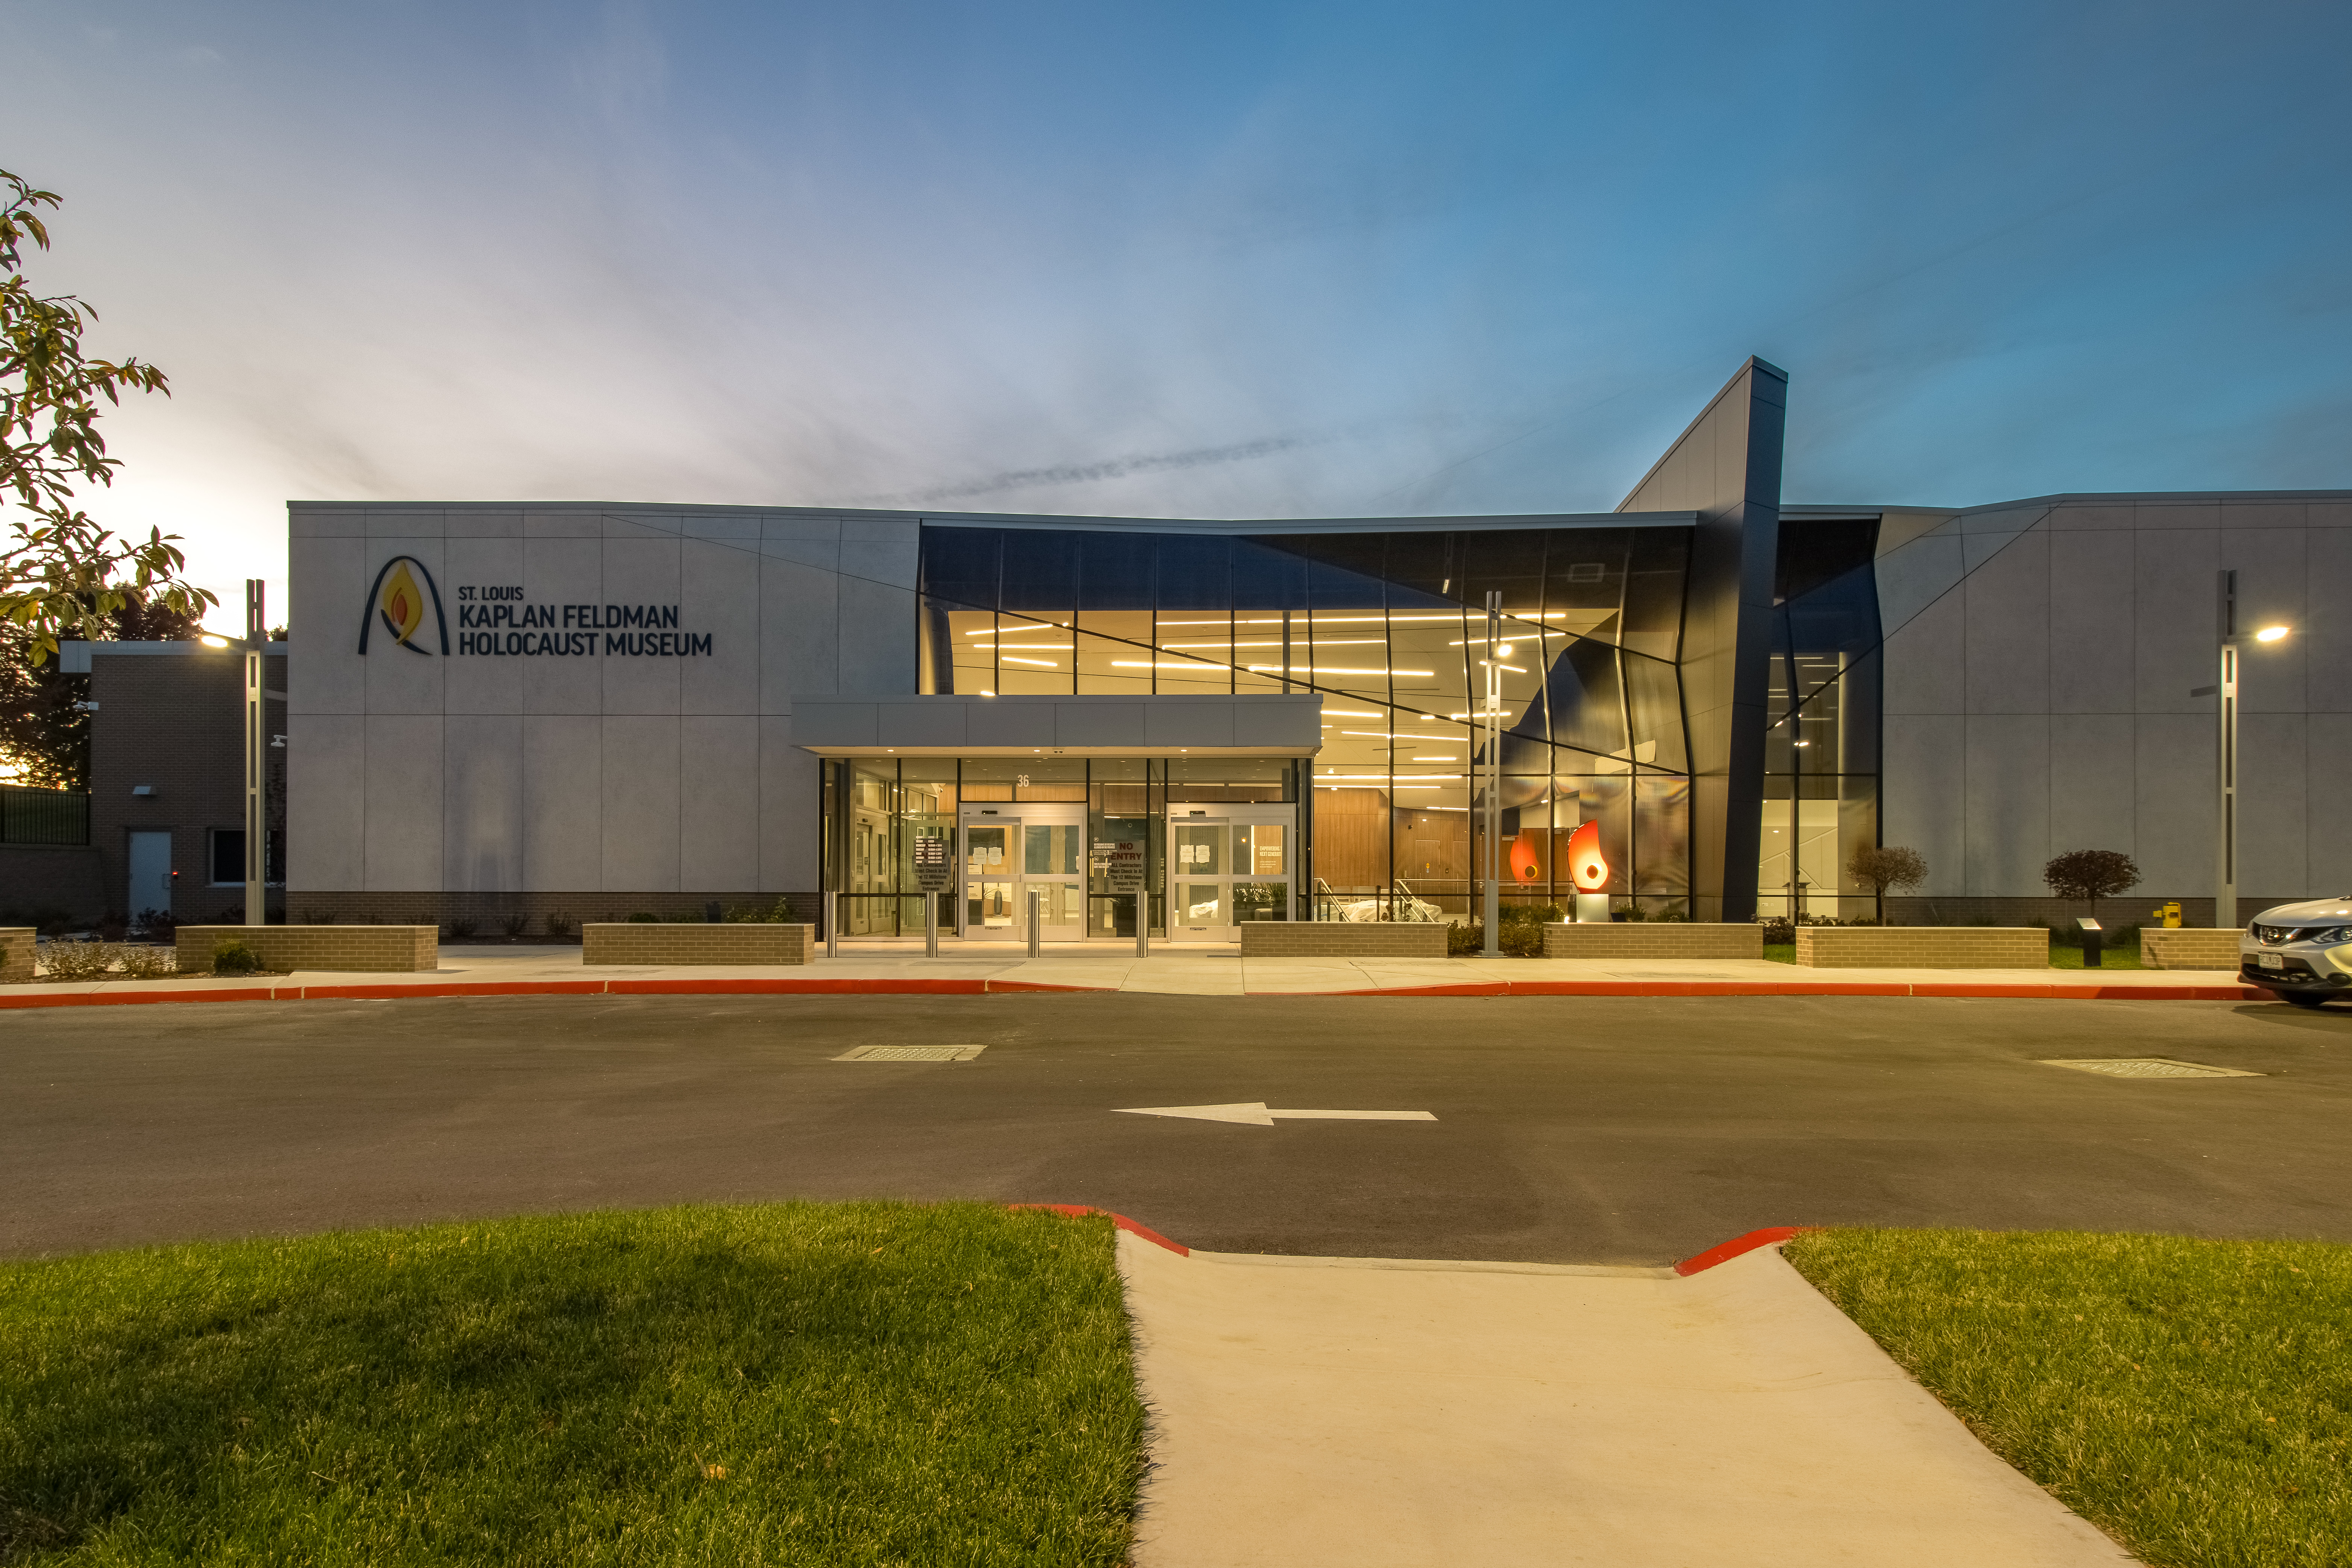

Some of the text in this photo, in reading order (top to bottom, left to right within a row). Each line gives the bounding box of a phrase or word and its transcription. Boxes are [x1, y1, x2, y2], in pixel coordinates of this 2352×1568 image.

[458, 586, 523, 601] ST. LOUIS
[459, 605, 678, 629] KAPLAN FELDMAN
[459, 632, 712, 657] HOLOCAUST MUSEUM
[1018, 775, 1029, 787] 36
